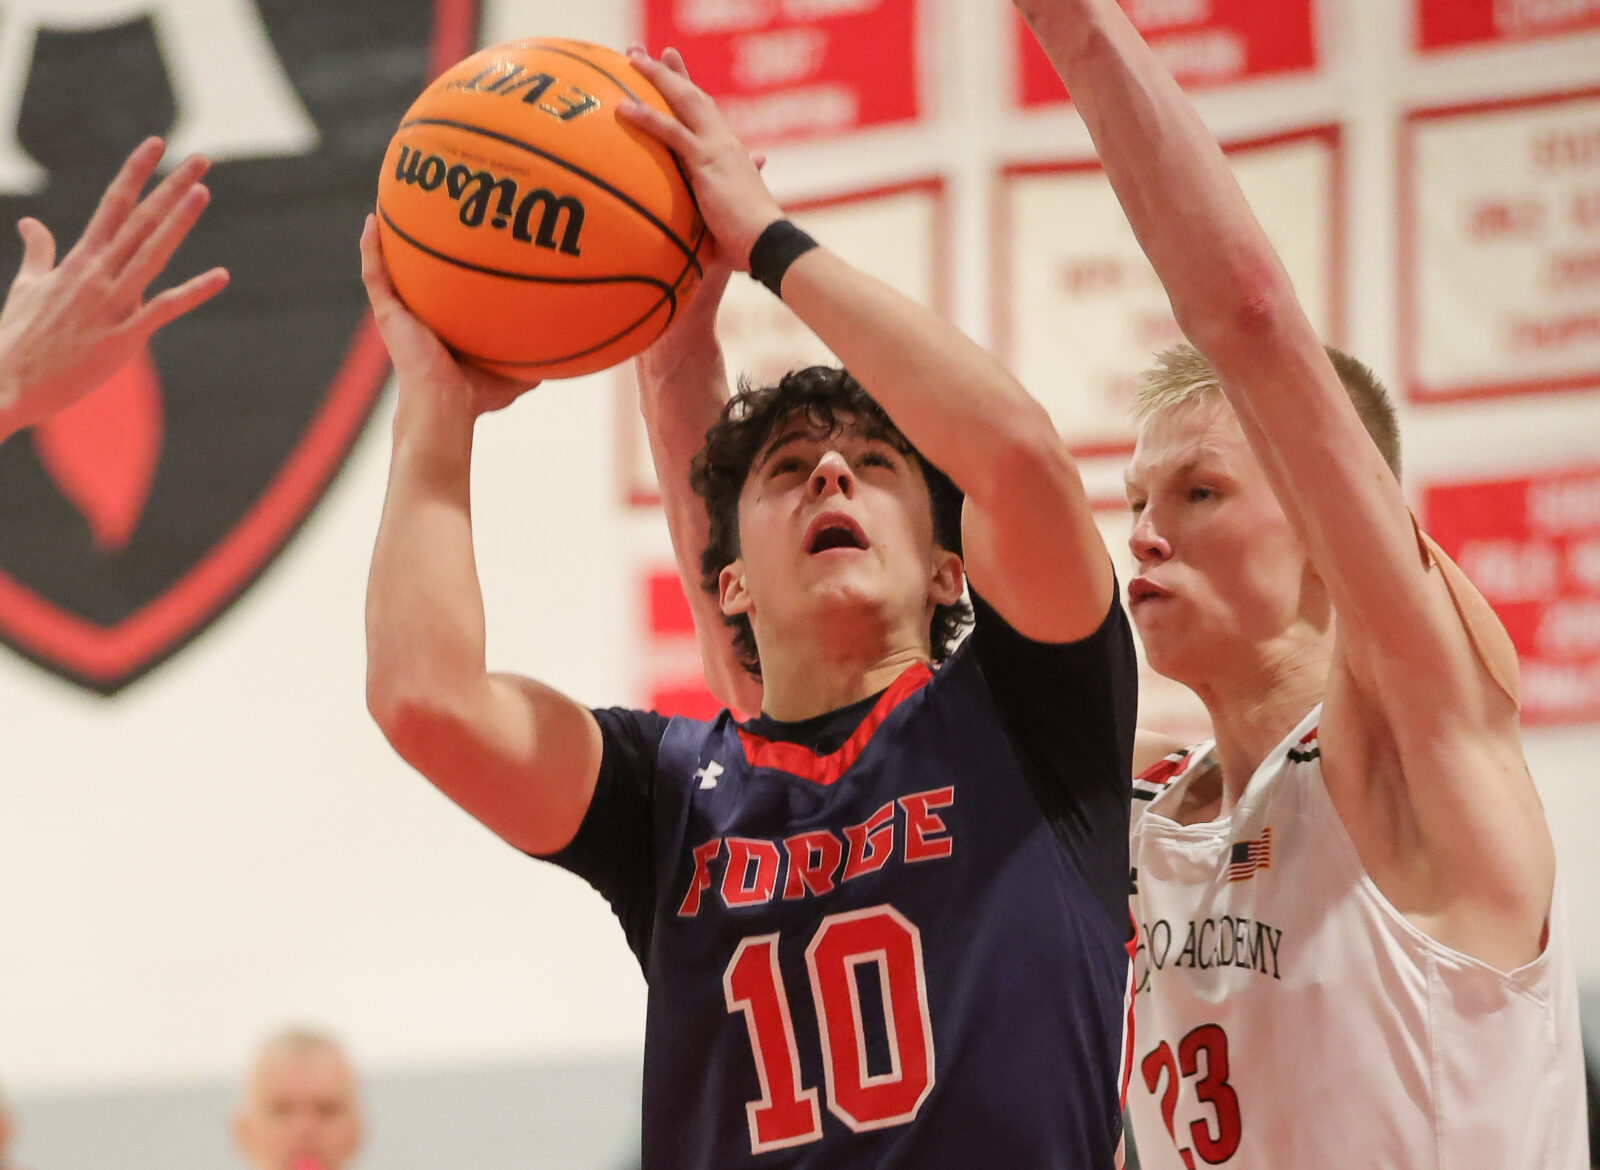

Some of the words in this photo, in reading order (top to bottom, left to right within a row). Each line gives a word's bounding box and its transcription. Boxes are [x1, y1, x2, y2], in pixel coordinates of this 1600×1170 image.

[395, 145, 586, 258] Wilson
[677, 785, 955, 917] FORGE
[1174, 914, 1283, 980] ACDEMY
[722, 903, 936, 1155] 10
[1140, 1022, 1243, 1170] 23
